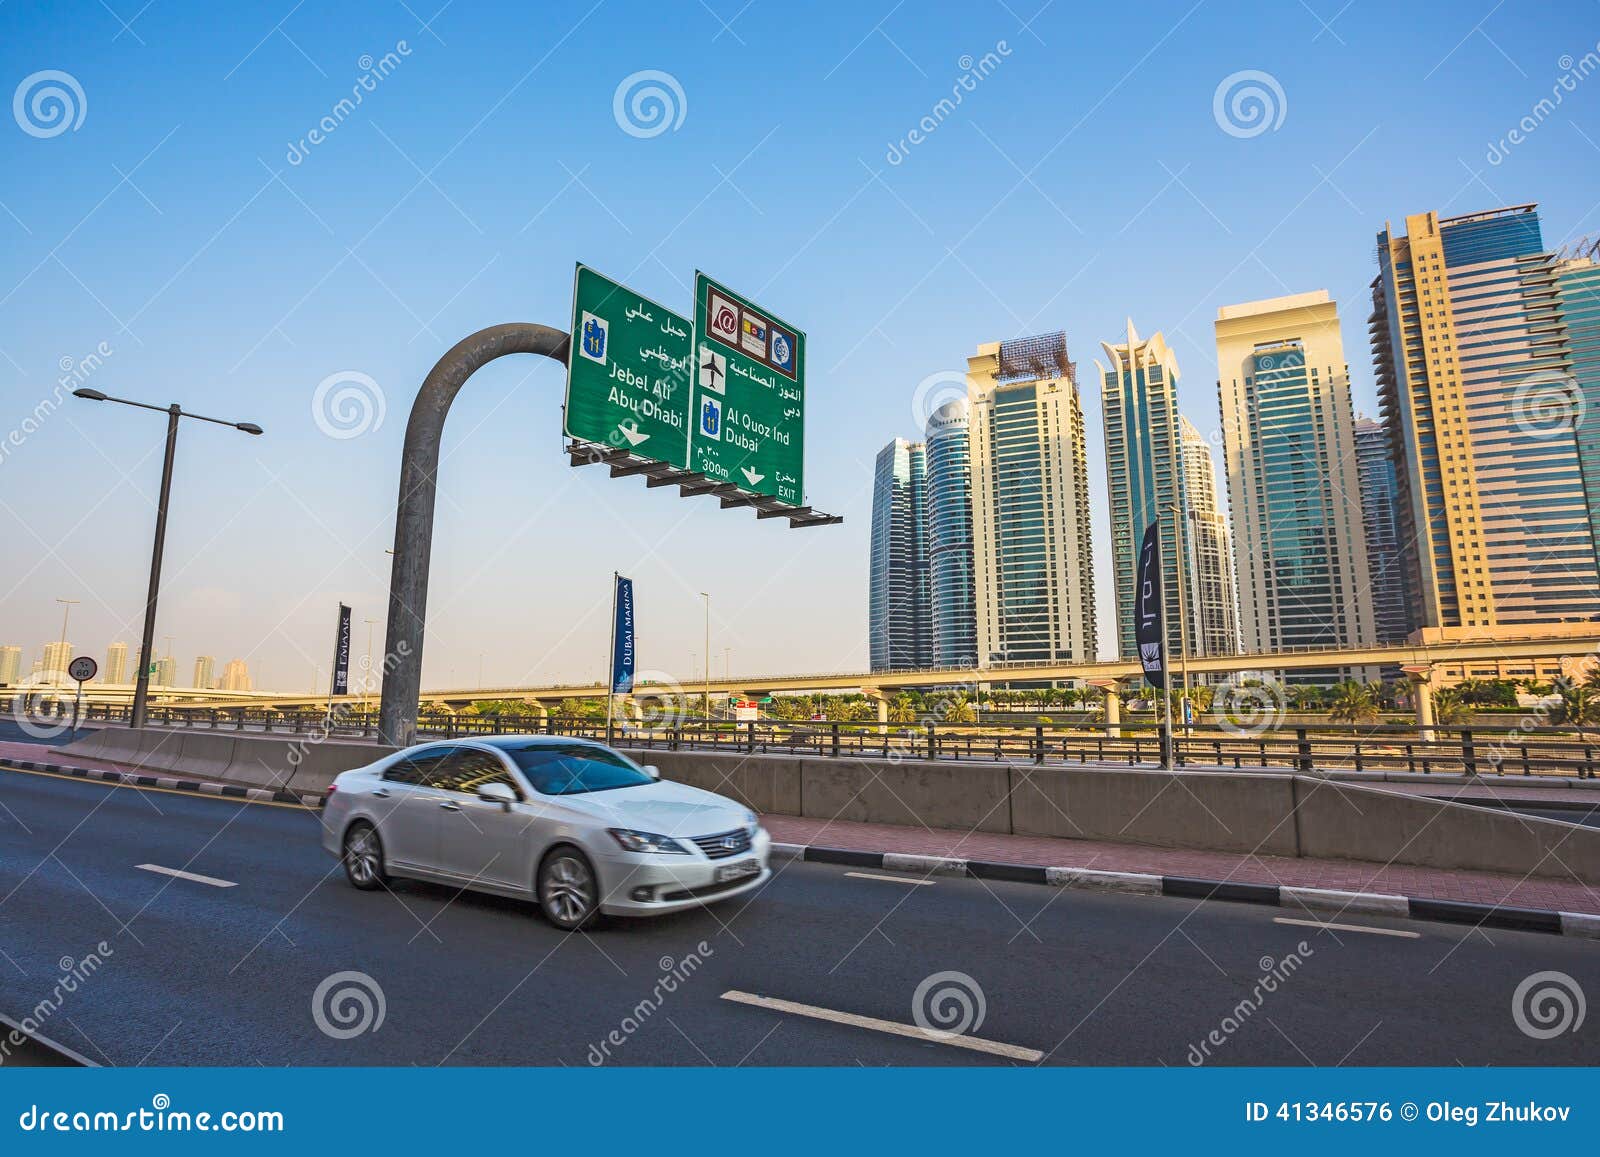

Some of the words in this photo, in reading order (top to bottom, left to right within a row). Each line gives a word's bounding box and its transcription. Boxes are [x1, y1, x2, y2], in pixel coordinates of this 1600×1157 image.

[625, 303, 653, 323] علي
[661, 317, 687, 341] جبل
[589, 336, 600, 354] 11
[609, 362, 649, 391] Jebel
[652, 380, 671, 401] Ali
[730, 358, 776, 389] الصناعية
[608, 386, 638, 411] Abu
[643, 399, 683, 428] Dhabi
[783, 407, 801, 420] دبي
[727, 408, 739, 425] Al
[742, 414, 770, 437] Quoz
[773, 426, 790, 445] Ind
[726, 427, 758, 452] Dubai
[702, 459, 729, 478] 300m
[778, 485, 796, 500] EXIT
[623, 583, 632, 627] MARINA
[623, 630, 632, 665] DUBAI
[76, 669, 90, 677] 60
